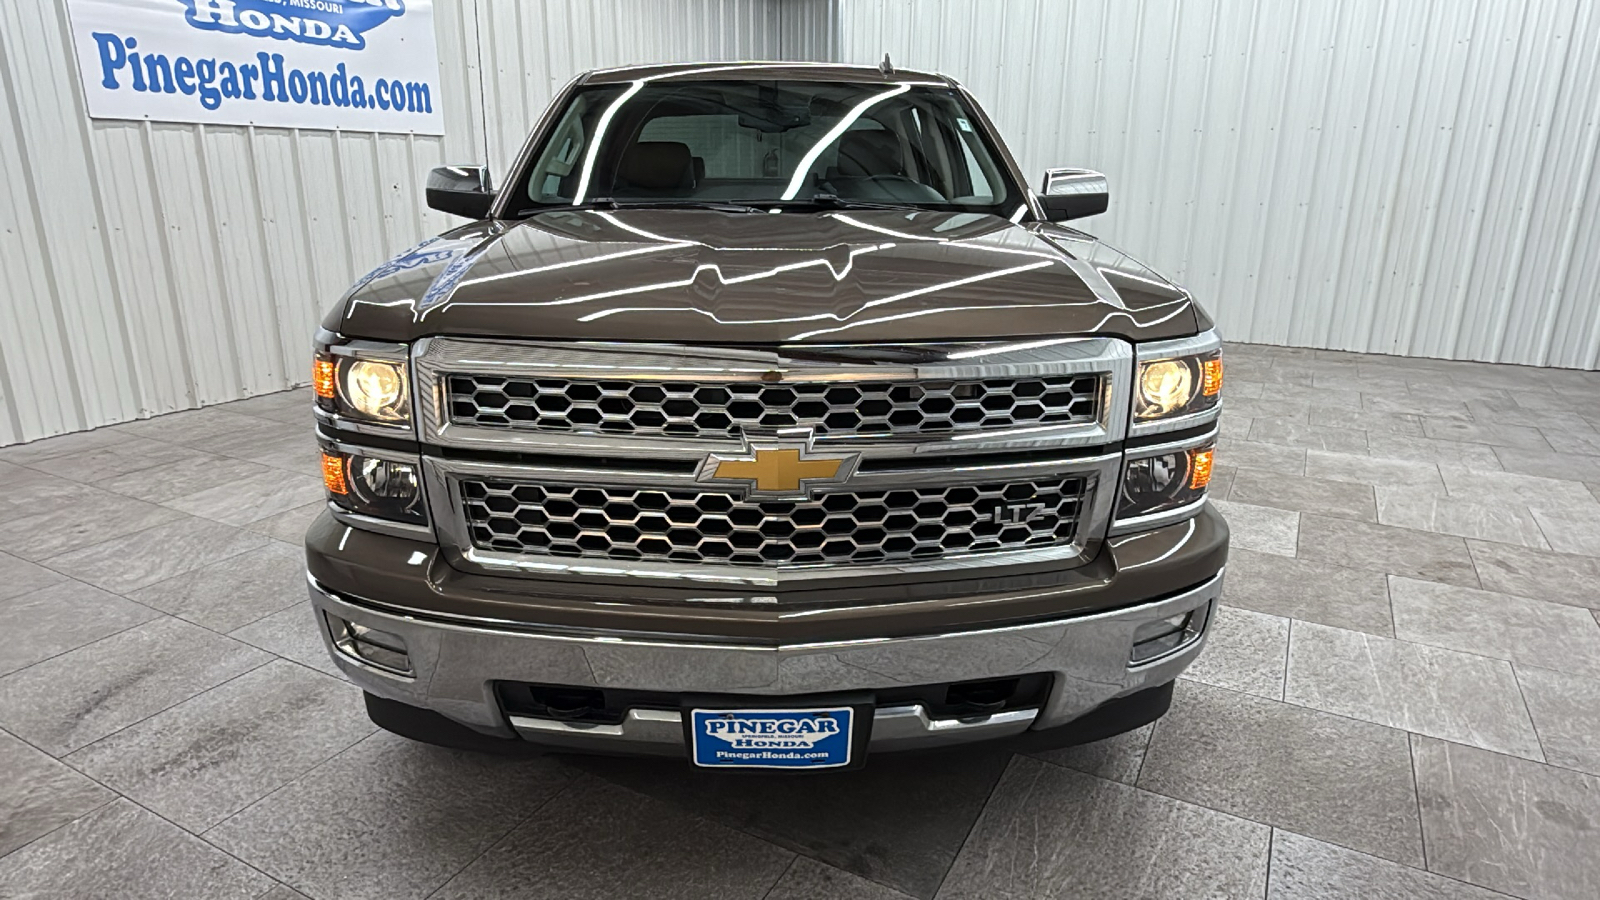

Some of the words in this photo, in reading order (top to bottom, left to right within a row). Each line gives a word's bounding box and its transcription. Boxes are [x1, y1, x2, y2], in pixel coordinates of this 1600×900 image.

[192, 0, 361, 44] HONDA
[93, 32, 433, 113] PinegarHonda.com
[994, 503, 1046, 524] LTZ
[707, 720, 836, 734] PINEGAR
[735, 739, 810, 747] HONDA
[716, 751, 829, 760] PinegarHonda.com
